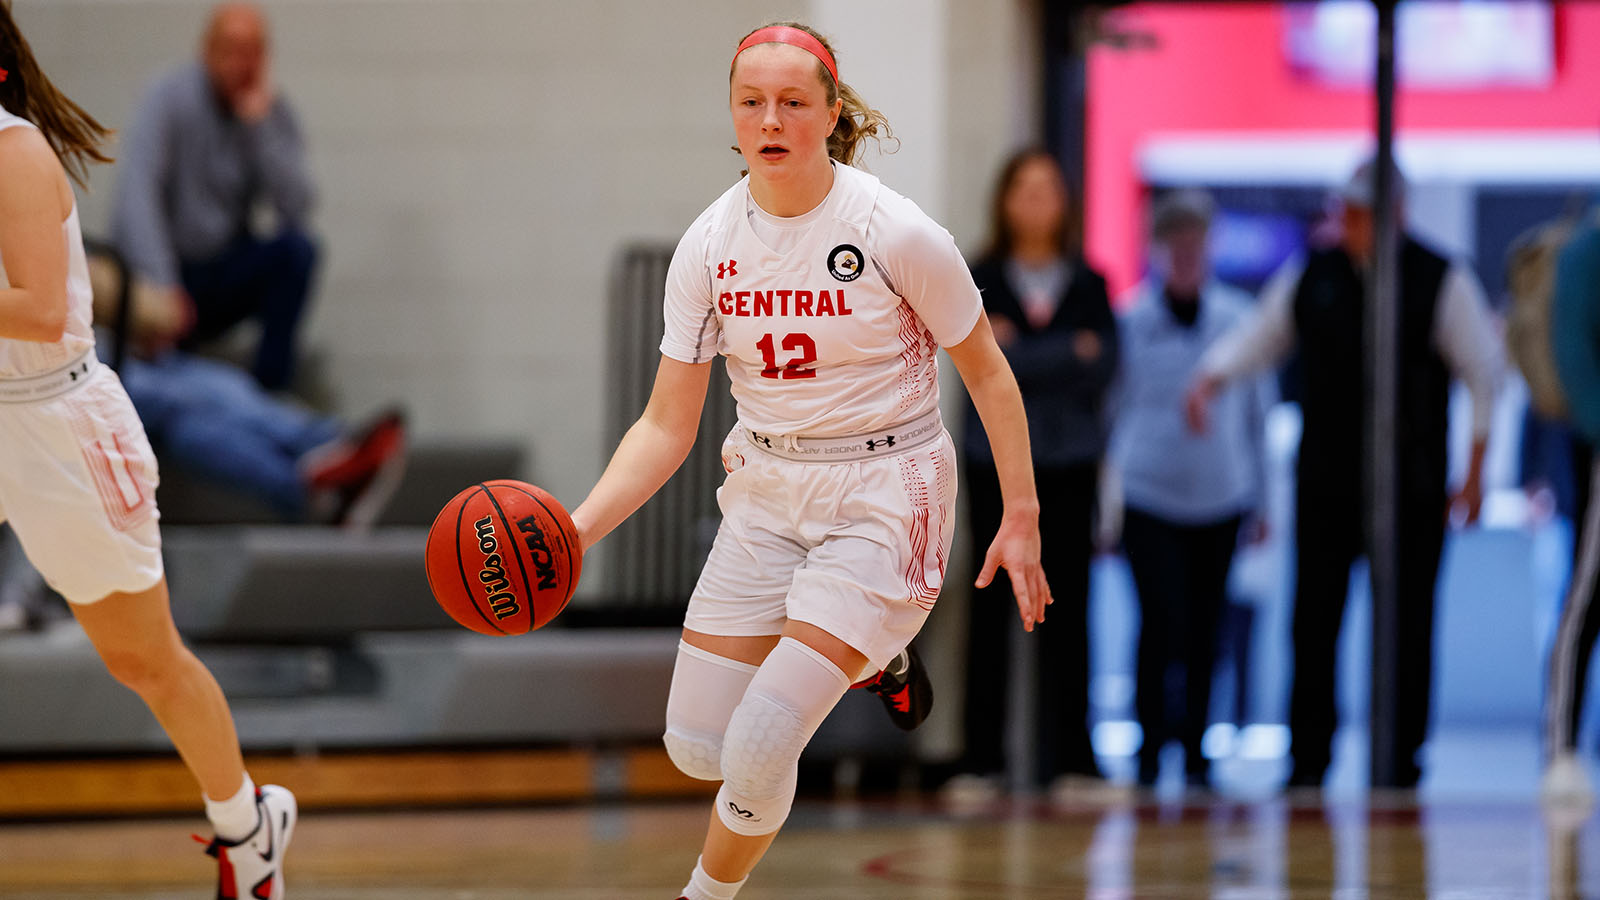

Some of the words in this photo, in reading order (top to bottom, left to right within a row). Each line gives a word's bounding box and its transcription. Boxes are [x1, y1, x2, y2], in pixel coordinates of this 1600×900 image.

[718, 289, 853, 317] CENTRAL
[755, 333, 818, 380] 12
[474, 515, 521, 621] Wilson
[516, 514, 557, 591] NCAA
